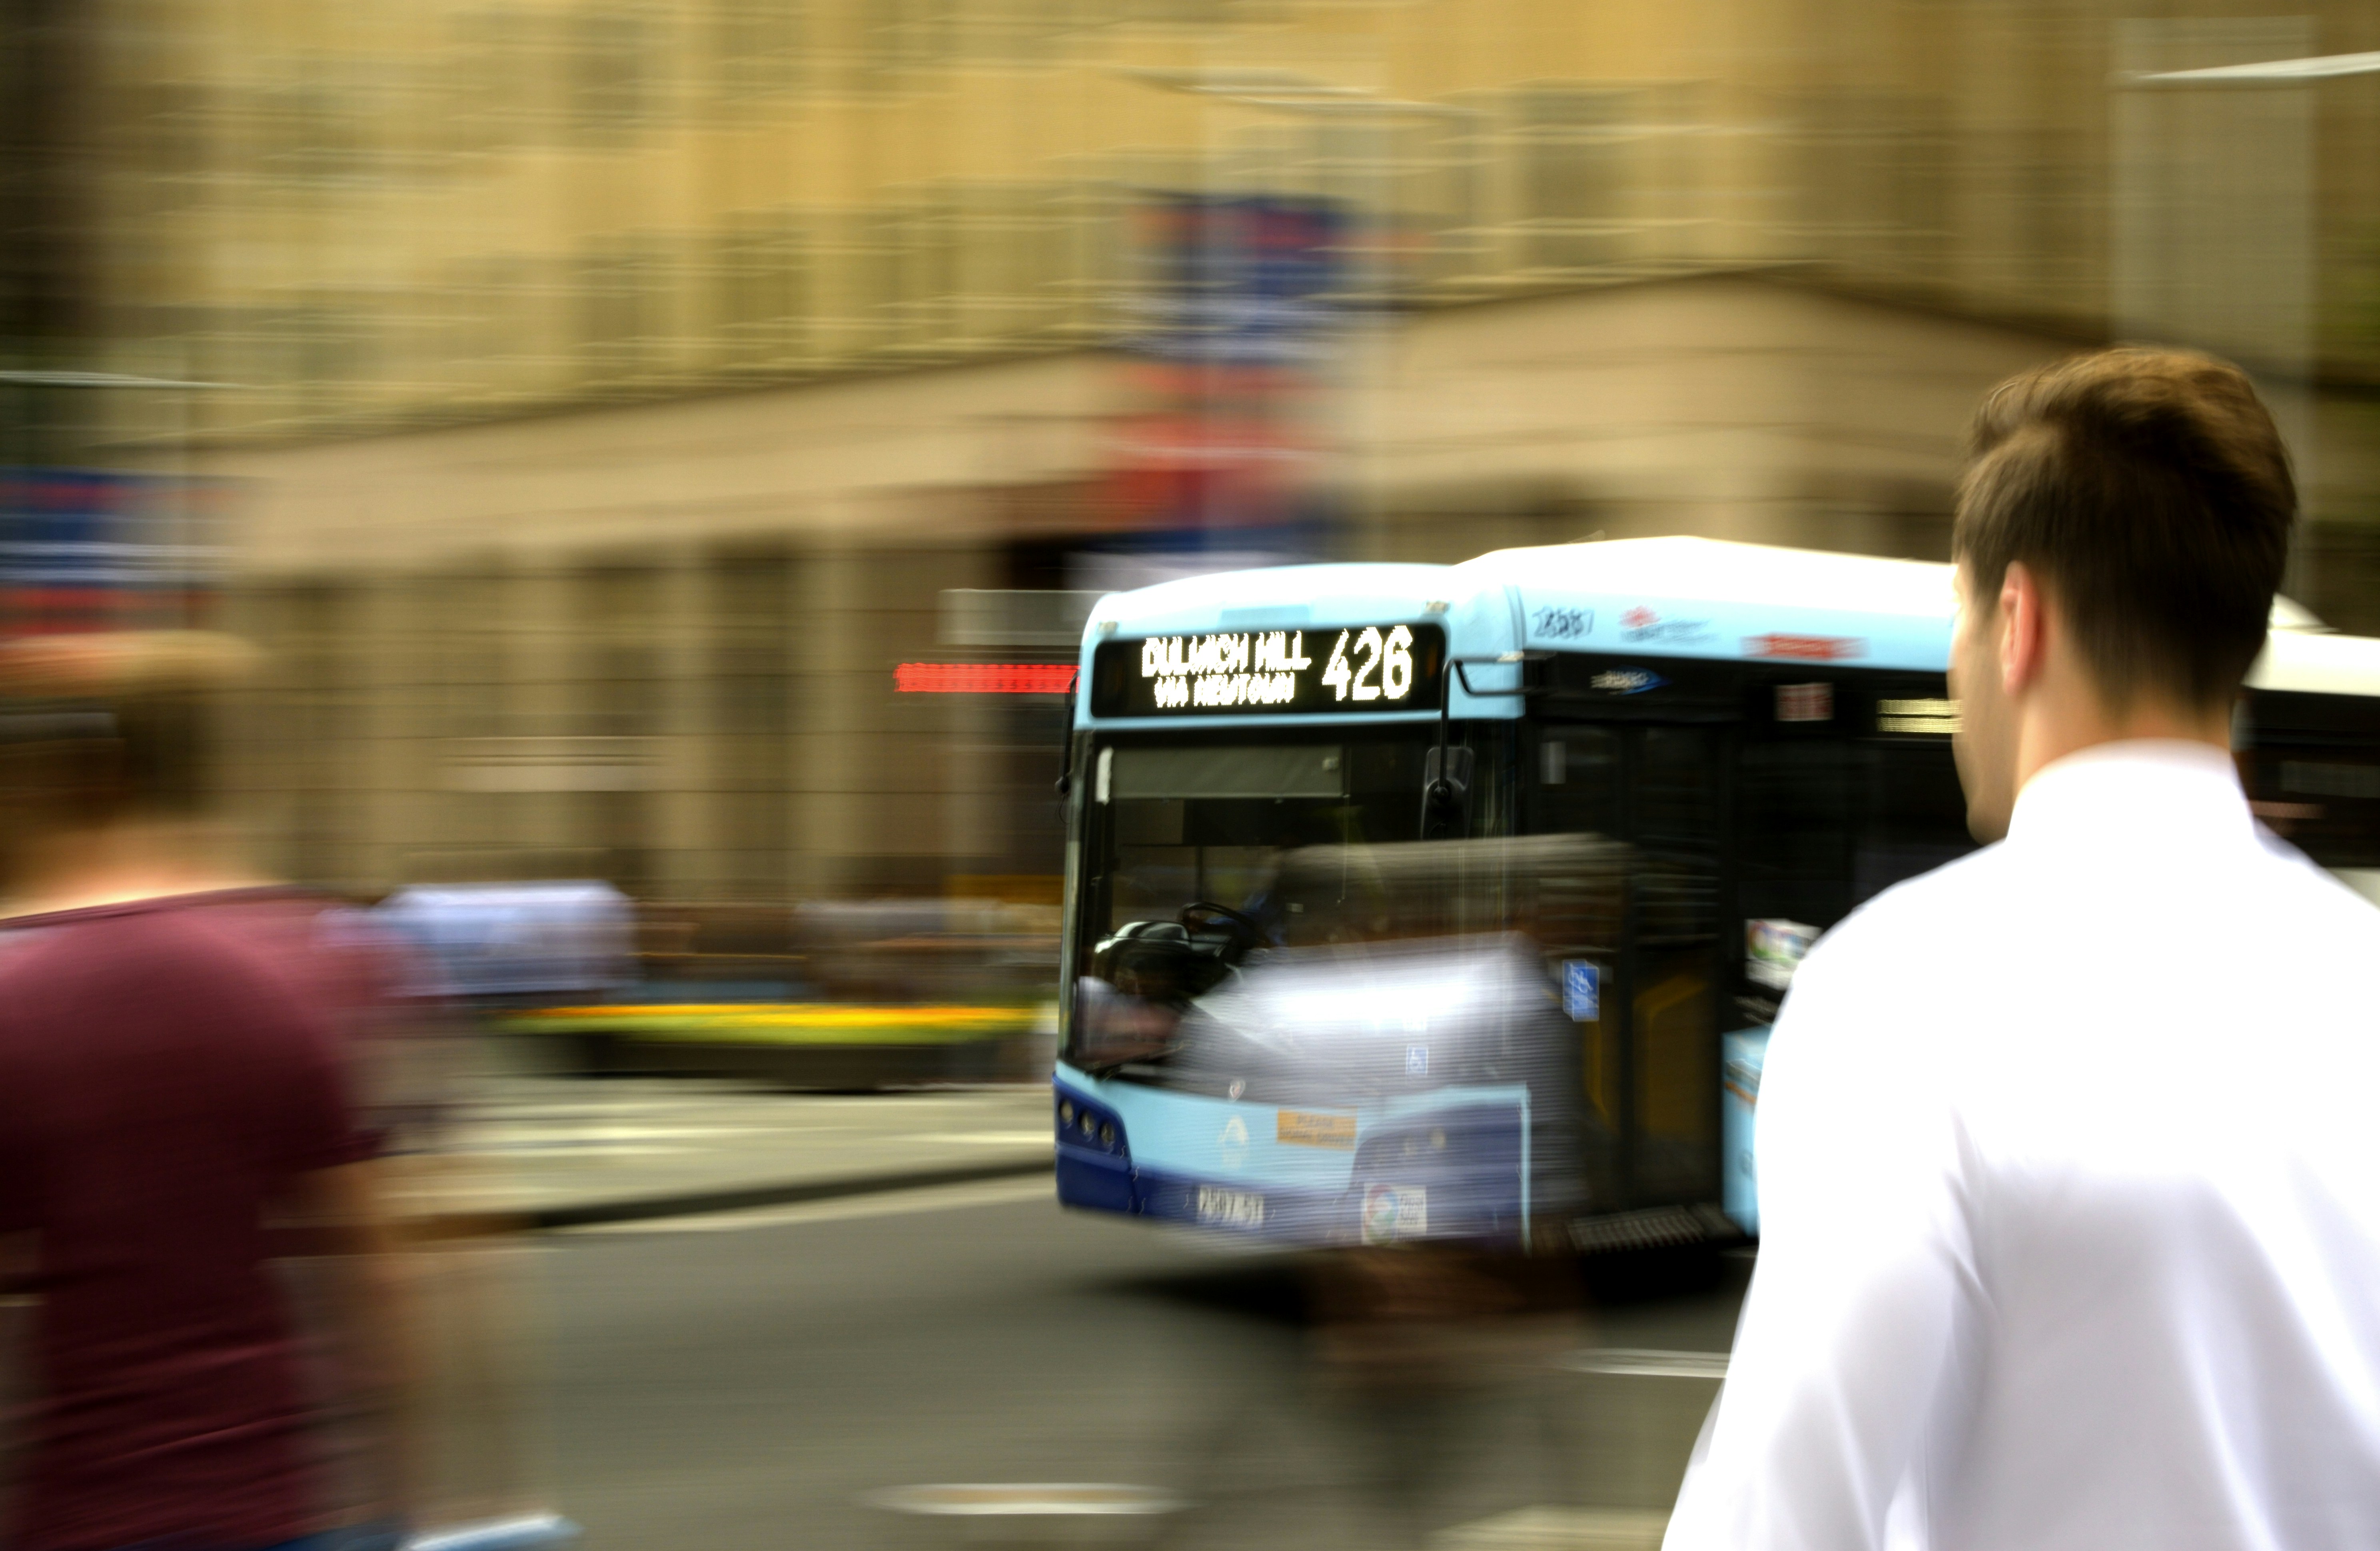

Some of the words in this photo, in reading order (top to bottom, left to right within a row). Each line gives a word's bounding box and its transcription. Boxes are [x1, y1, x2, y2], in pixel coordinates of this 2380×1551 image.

[1142, 633, 1249, 677] DULWICH
[1255, 630, 1312, 672] HILL
[1322, 625, 1413, 702] 426
[1154, 676, 1189, 708] VIA
[1194, 672, 1295, 707] NEWTOWN
